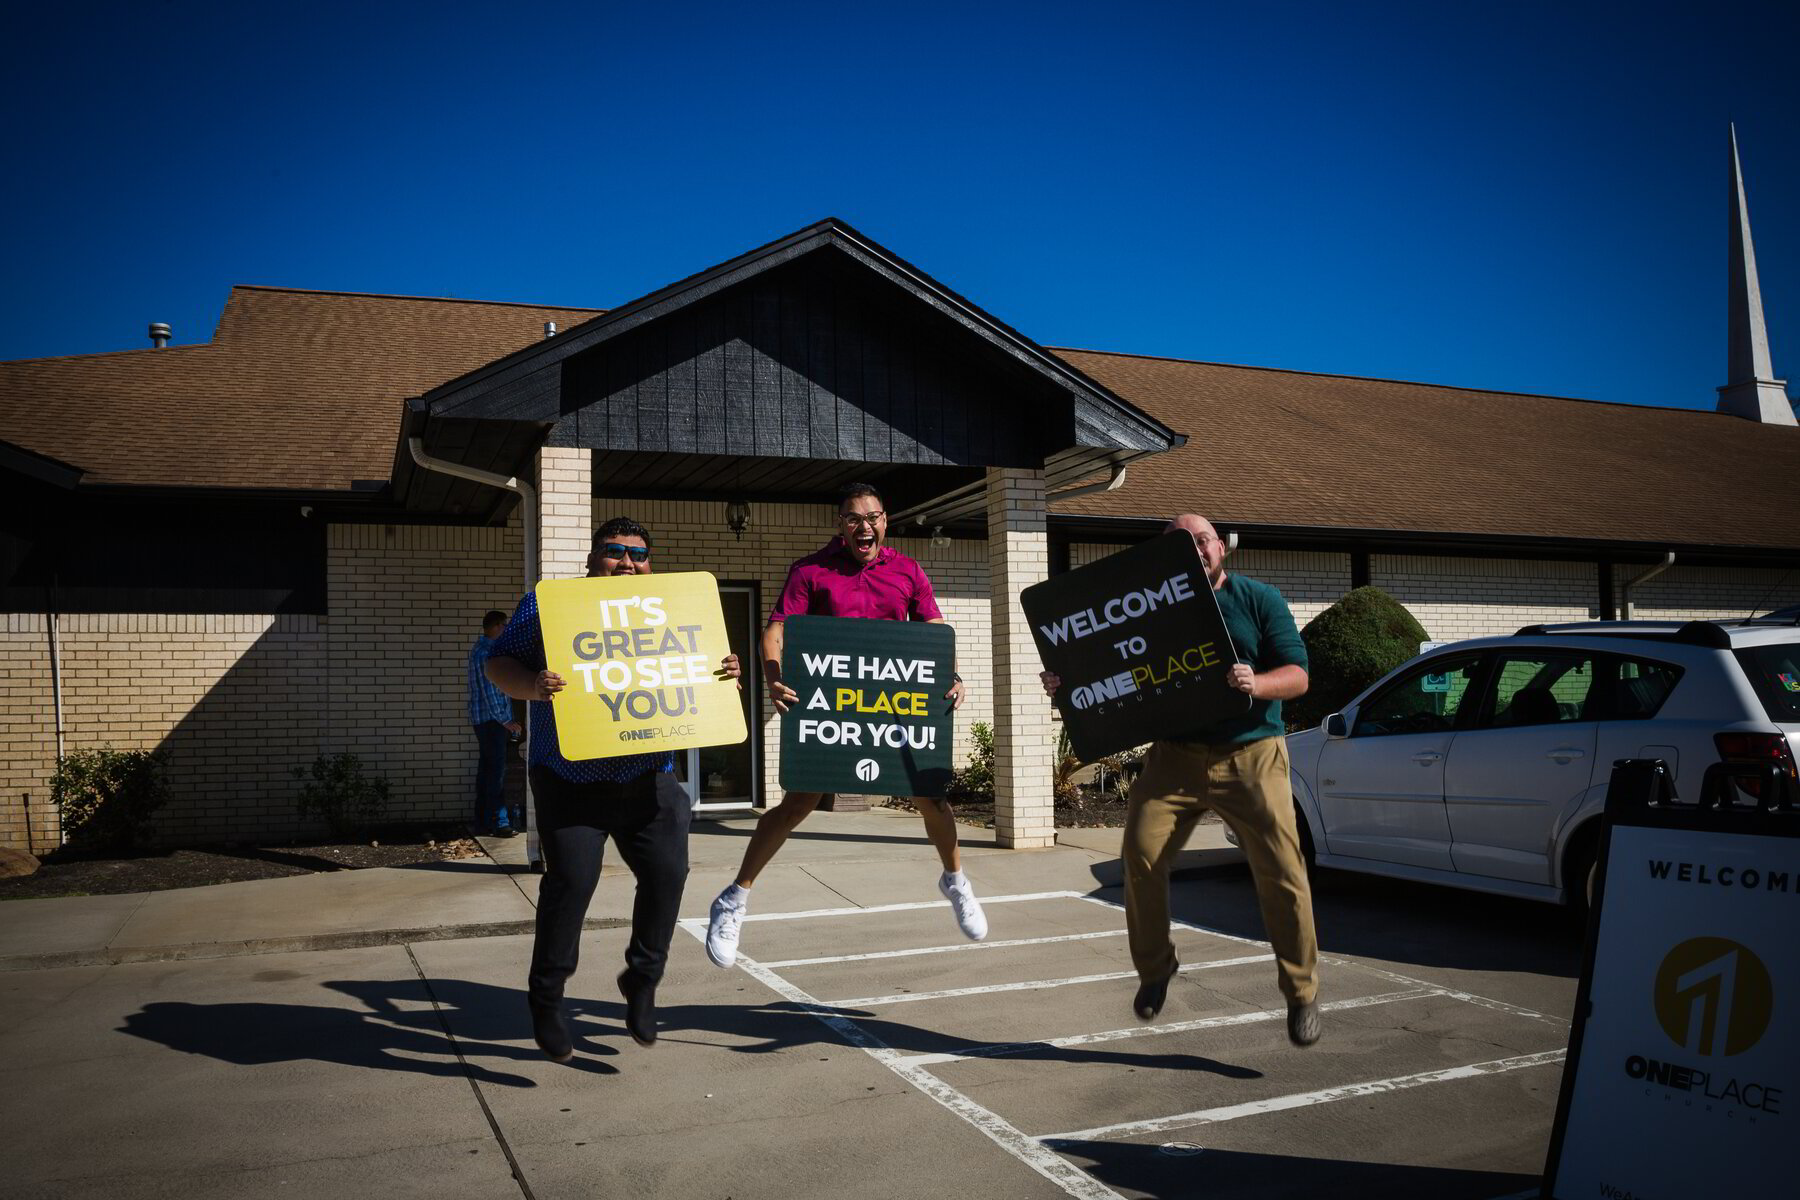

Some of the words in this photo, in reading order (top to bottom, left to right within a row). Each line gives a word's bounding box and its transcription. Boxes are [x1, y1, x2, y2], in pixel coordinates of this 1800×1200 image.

[599, 595, 668, 629] IT'S
[1040, 573, 1195, 647] WELCOME
[572, 625, 702, 661] GREAT
[1113, 636, 1147, 660] TO
[572, 662, 633, 693] TO
[635, 655, 713, 688] SEE
[802, 653, 850, 679] WE
[858, 656, 936, 684] HAVE
[598, 686, 698, 722] YOU!
[806, 687, 831, 711] A
[836, 687, 929, 716] PLACE
[1099, 674, 1202, 715] CHURCH
[799, 719, 862, 746] FOR
[866, 723, 936, 750] YOU!
[1649, 860, 1800, 894] WELCOM
[1645, 1089, 1757, 1124] CHURCH
